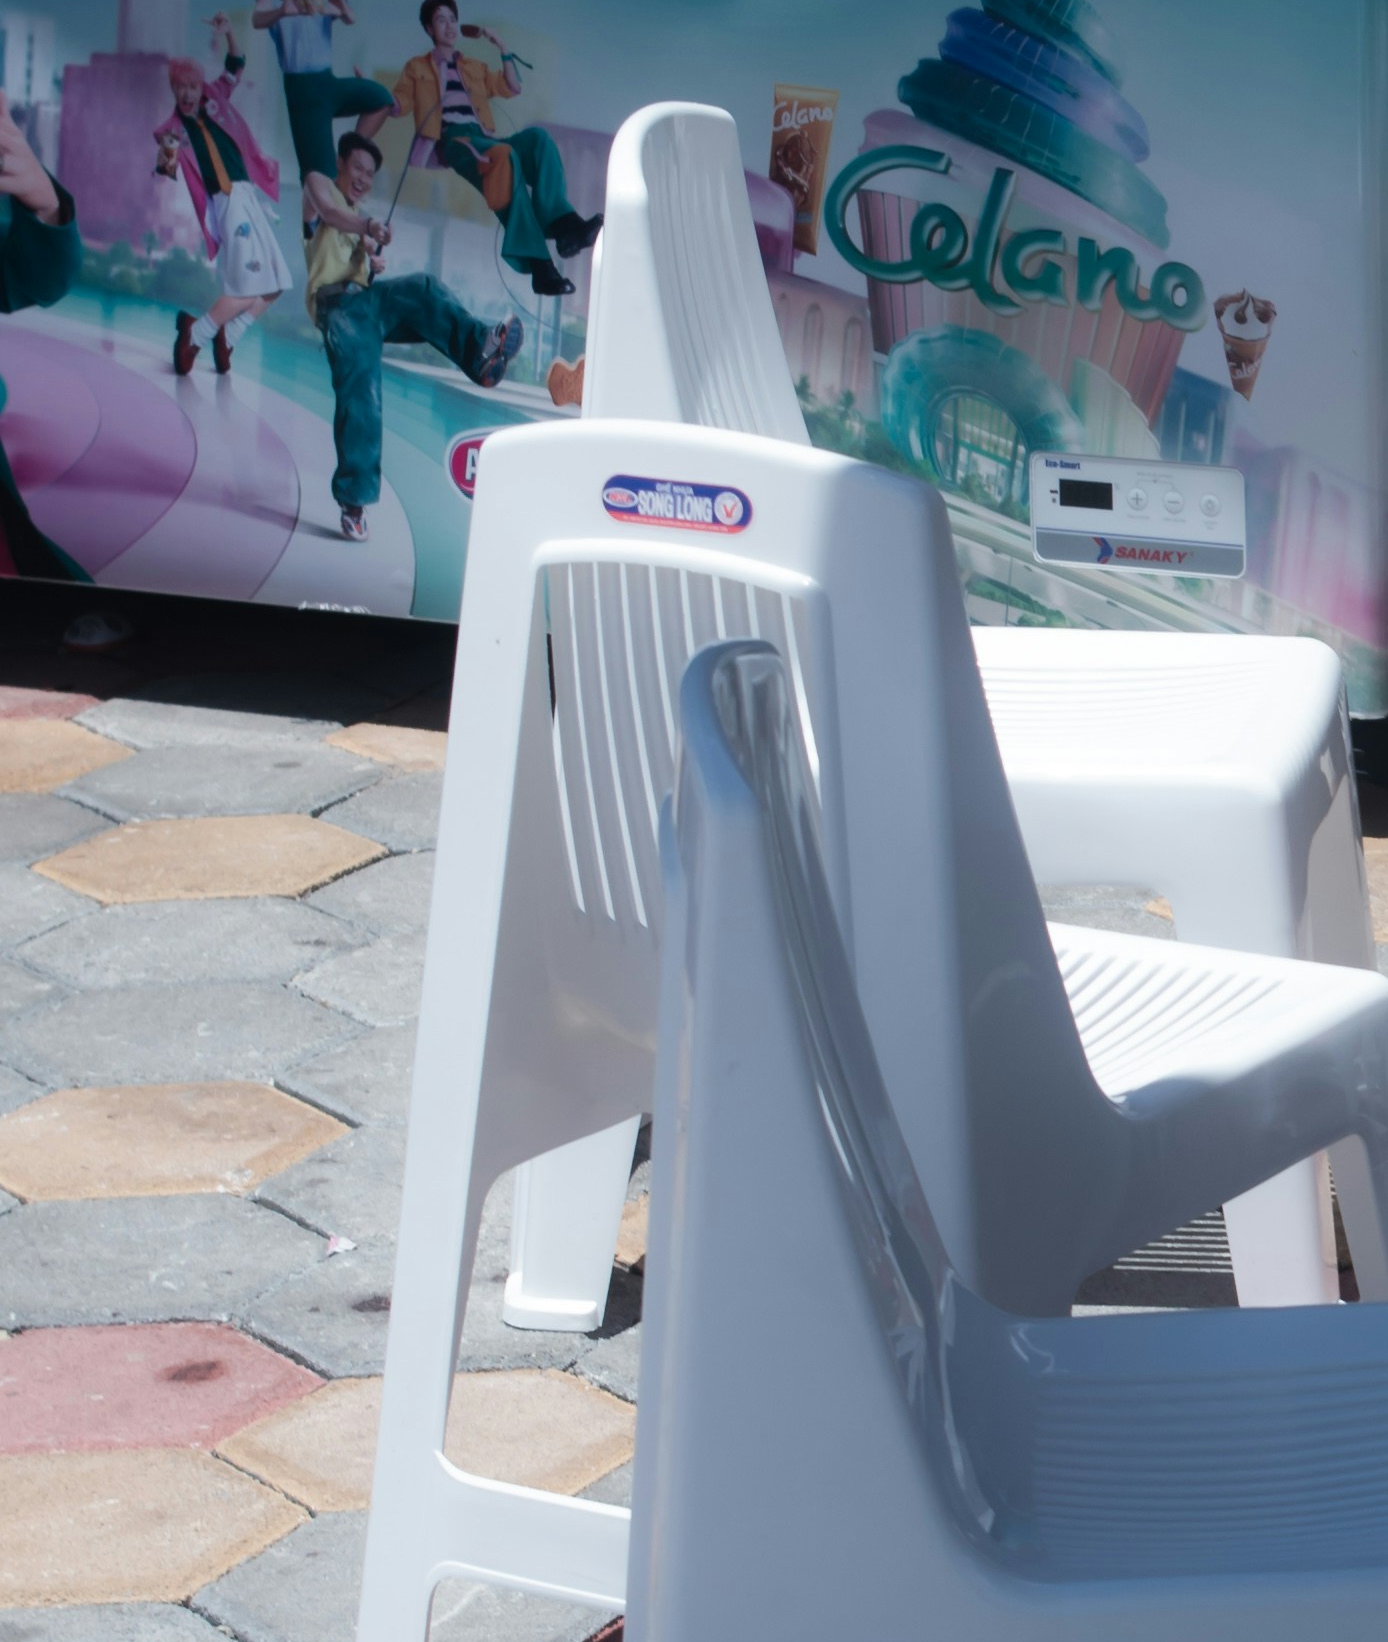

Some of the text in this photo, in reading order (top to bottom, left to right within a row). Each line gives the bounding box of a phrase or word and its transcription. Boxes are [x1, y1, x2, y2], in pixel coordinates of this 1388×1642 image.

[772, 100, 833, 133] Celano
[824, 145, 1207, 333] Celano
[1045, 459, 1081, 470] Eco-Smart
[637, 489, 674, 517] SONG
[676, 494, 713, 523] LONG
[1115, 545, 1188, 564] SANAKY
